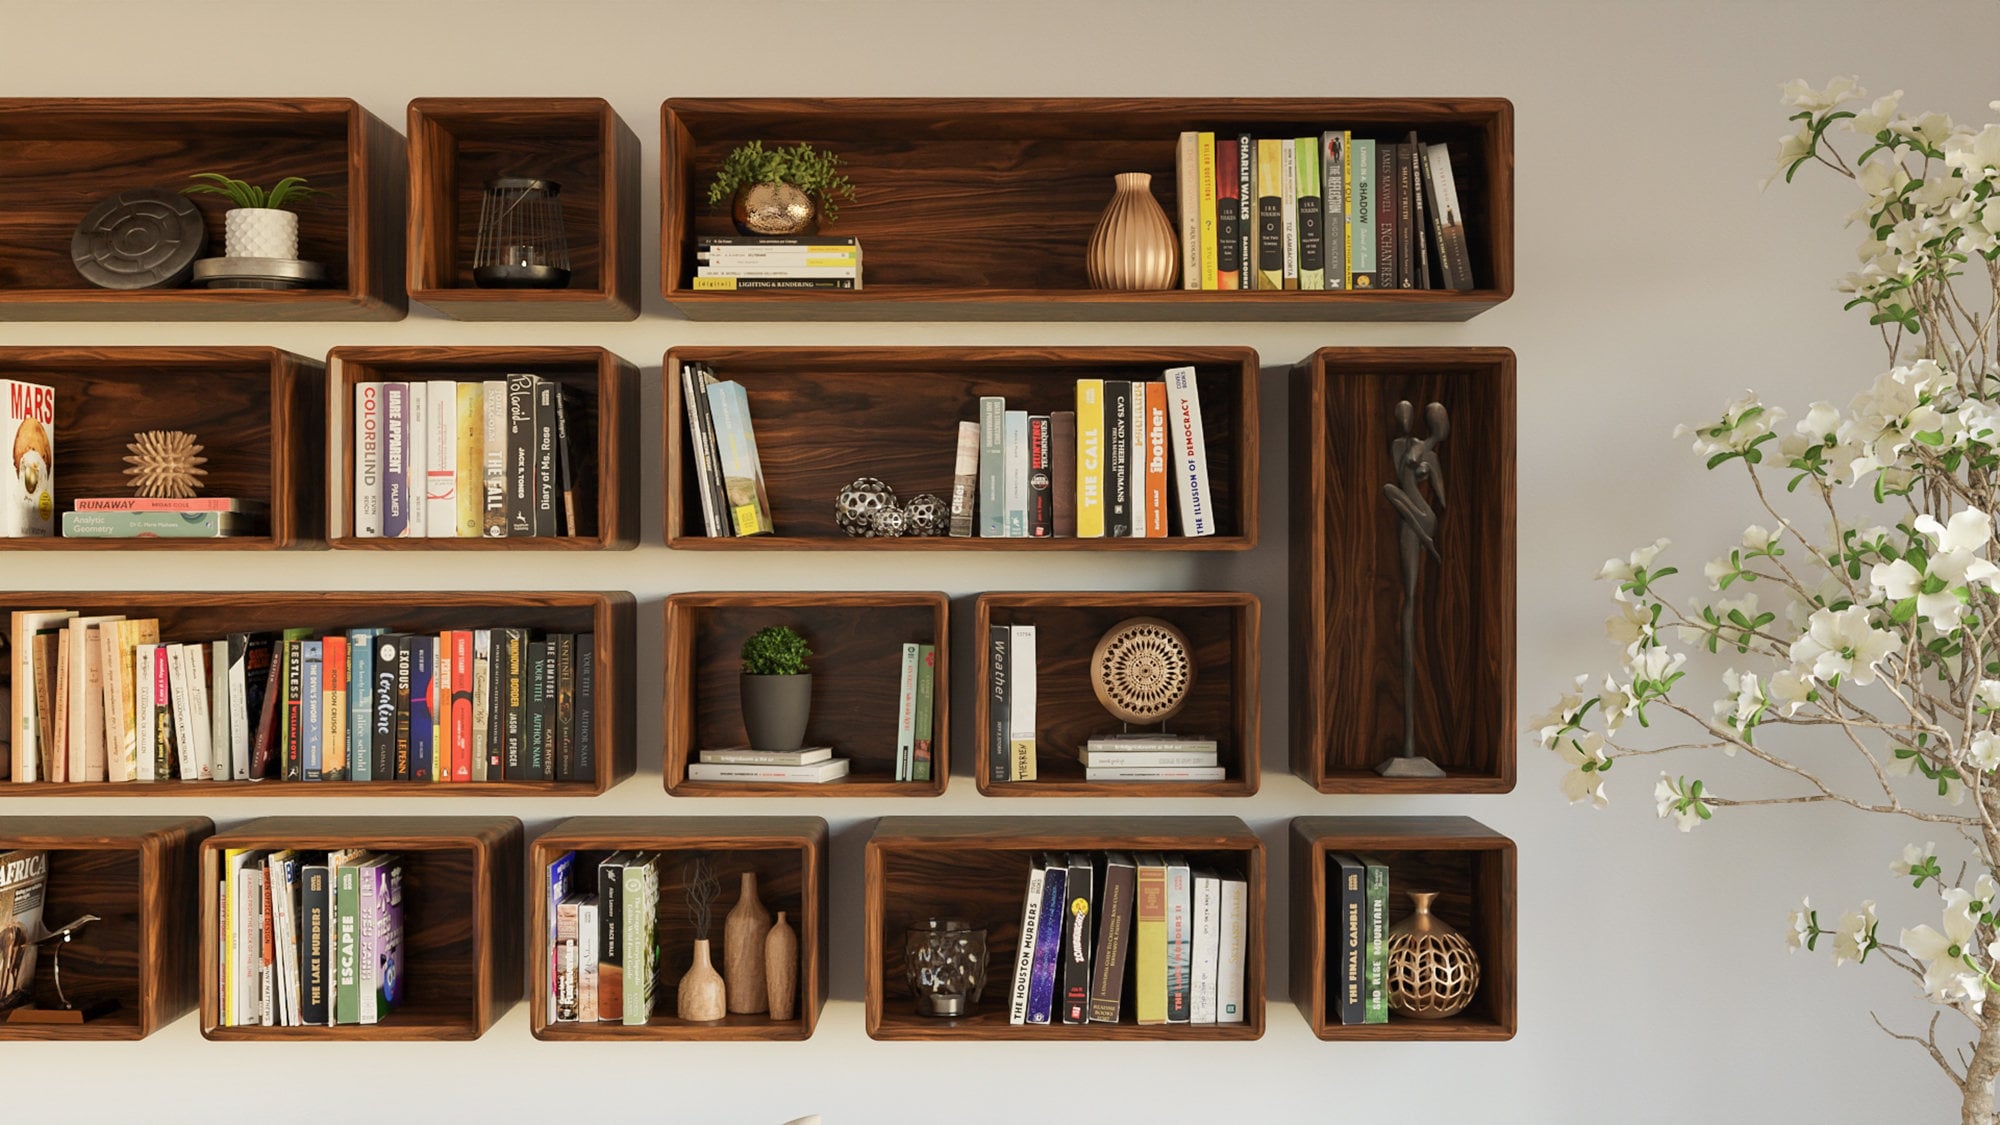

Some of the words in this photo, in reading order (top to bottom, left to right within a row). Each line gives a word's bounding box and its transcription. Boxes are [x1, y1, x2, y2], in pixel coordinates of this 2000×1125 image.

[1241, 136, 1249, 181] CHARLIE
[1382, 150, 1391, 174] JAMES
[1241, 185, 1249, 220] WALKS
[1359, 182, 1368, 224] SHADOW
[1382, 175, 1391, 213] MAXWELL
[1381, 223, 1393, 288] ENCHANTRESS
[10, 383, 53, 425] MARS
[389, 390, 402, 419] HARE
[494, 389, 503, 415] JOHN
[1117, 396, 1125, 418] CATS
[364, 387, 376, 486] COLORBLIND
[1117, 419, 1125, 438] AND
[1180, 398, 1194, 457] DEMOCRACY
[389, 419, 402, 474] APPARENT
[1032, 420, 1041, 469] HUNTING
[1085, 428, 1098, 470] CALL
[1117, 439, 1125, 464] THEIR
[488, 450, 503, 476] THE
[541, 452, 550, 470] Ms.
[1188, 458, 1196, 472] OF
[540, 471, 550, 482] of
[1085, 475, 1098, 507] THE
[1117, 465, 1125, 503] HUMANS
[79, 500, 136, 510] RUNAWAY
[391, 483, 400, 517] PALMER
[488, 479, 503, 511] FALL
[540, 484, 552, 510] Diary
[952, 485, 965, 514] Cities
[1190, 474, 1202, 515] ILLUSION
[73, 516, 106, 526] Analytic
[73, 524, 114, 534] Geometry
[1195, 518, 1205, 535] THE
[510, 638, 520, 675] UNKNOWN
[546, 641, 555, 656] THE
[561, 639, 570, 680] SENTINEL
[582, 652, 592, 675] YOUR
[290, 644, 299, 699] RESTLESS
[399, 650, 409, 690] EXODUS
[534, 659, 544, 681] YOUR
[546, 658, 555, 699] COMATOSE
[994, 640, 1006, 703] Weather
[510, 677, 520, 707] BORDER
[534, 682, 543, 703] TITLE
[582, 677, 591, 697] TITLE
[377, 672, 395, 734] Coraline
[356, 714, 366, 737] alice
[509, 712, 517, 734] JASON
[533, 713, 543, 745] AUTHOR
[581, 709, 590, 743] AUTHOR
[356, 740, 367, 771] sebold
[398, 750, 408, 774] PENN
[509, 737, 517, 767] SPENCER
[532, 746, 541, 769] NAME
[544, 749, 552, 775] MYERS
[580, 744, 588, 768] NAME
[1017, 743, 1030, 780] THERRIEN
[0, 852, 46, 887] AFRICA
[312, 907, 321, 956] MURDERS
[1023, 902, 1037, 949] MURDERS
[1174, 915, 1183, 961] MURDERS
[1349, 903, 1358, 948] GAMBLE
[1373, 899, 1382, 956] MOUNTAIN
[342, 915, 354, 985] ESCAPEE
[1348, 949, 1358, 981] FINAL
[312, 958, 321, 984] LAKE
[1016, 951, 1031, 999] HOUSTON
[1174, 965, 1183, 991] LAKE
[1372, 960, 1382, 986] RISE
[312, 985, 321, 1005] THE
[1174, 992, 1183, 1011] THE
[1349, 984, 1358, 1005] THE
[1372, 990, 1382, 1010] SAD
[1014, 1002, 1023, 1020] THE
